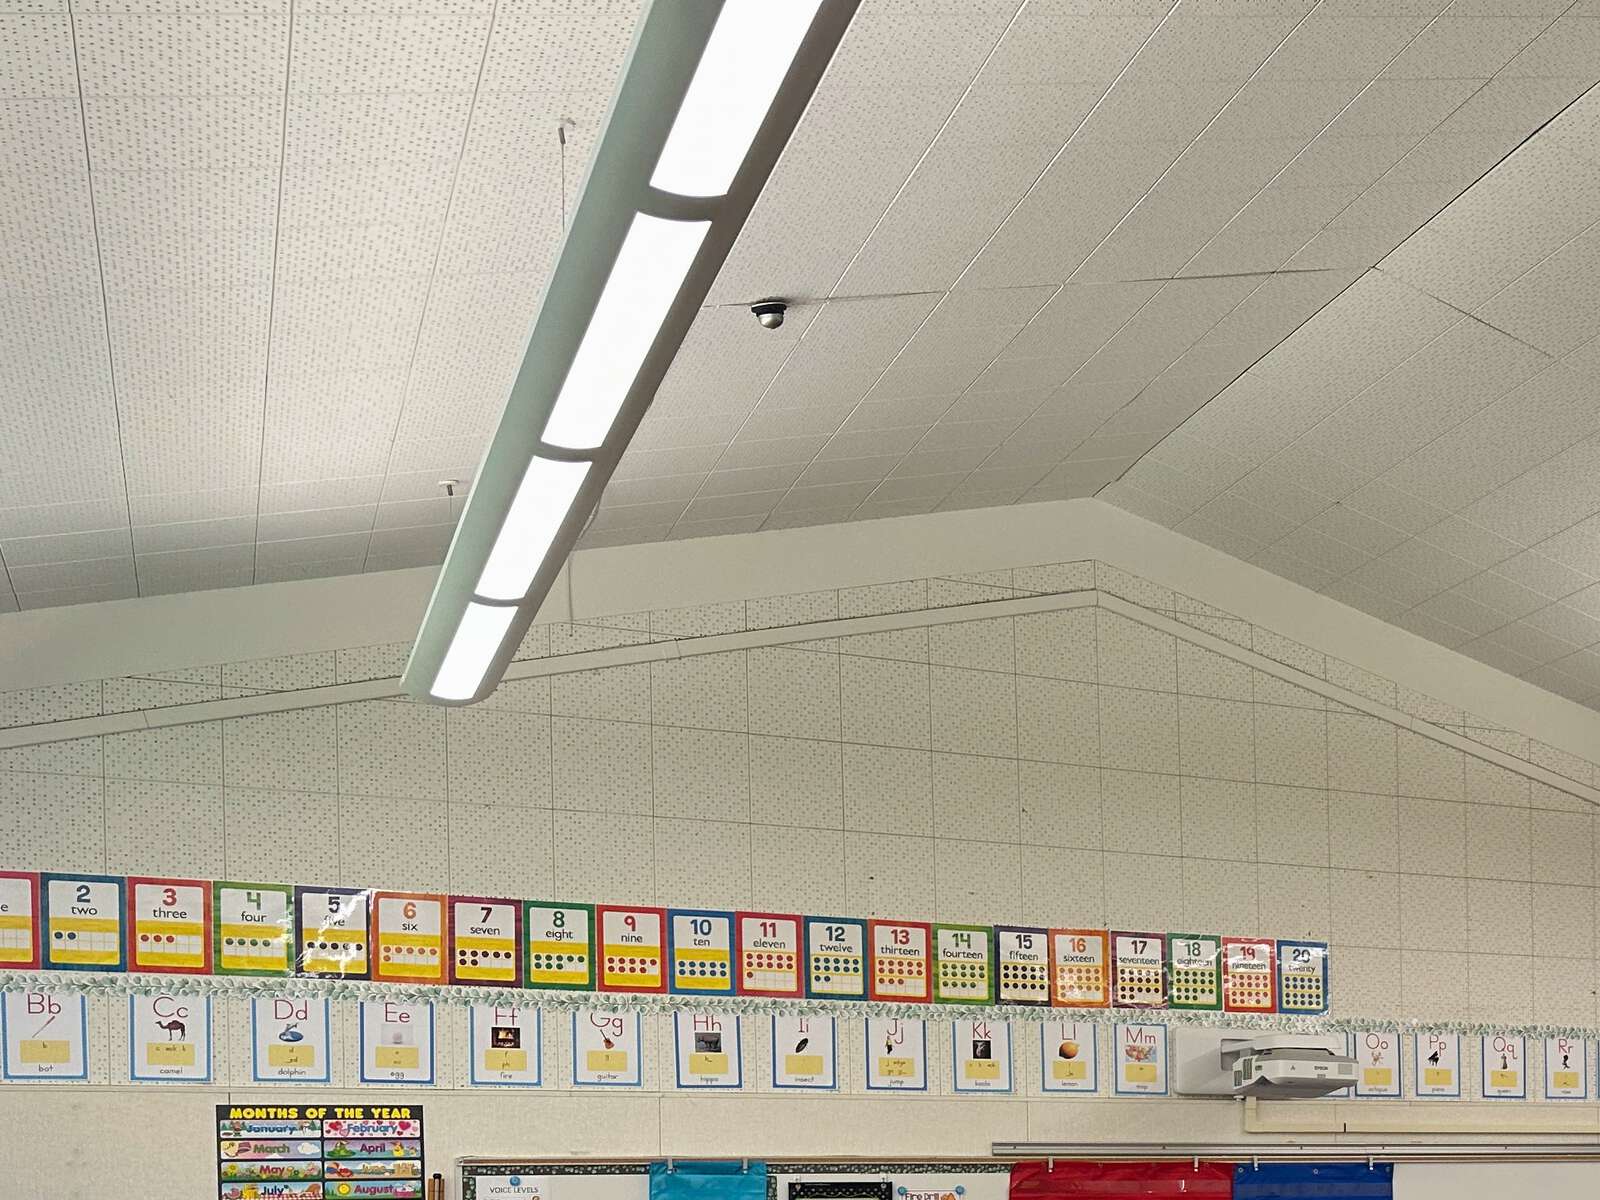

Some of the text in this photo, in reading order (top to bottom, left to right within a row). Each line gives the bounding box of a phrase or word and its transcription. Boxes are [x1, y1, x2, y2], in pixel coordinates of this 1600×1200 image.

[75, 885, 91, 902] 2
[162, 888, 177, 905] 3
[246, 892, 262, 909] 4
[71, 906, 97, 916] two
[328, 896, 340, 913] 5
[403, 902, 417, 919] 6
[152, 908, 187, 919] three
[241, 911, 267, 923] four
[480, 907, 492, 923] 7
[553, 911, 565, 928] 8
[401, 922, 418, 931] six
[470, 926, 500, 935] seven
[624, 916, 636, 931] 9
[690, 919, 712, 936] 10
[760, 922, 777, 938] 11
[545, 929, 574, 941] eight
[620, 934, 643, 943] nine
[825, 926, 846, 942] 12
[891, 929, 910, 944] 13
[952, 933, 970, 949] 14
[1015, 934, 1033, 949] 15
[693, 938, 710, 947] ten
[753, 939, 786, 950] eleven
[820, 943, 853, 953] twelve
[1068, 938, 1086, 953] 16
[1131, 940, 1148, 954] 17
[1185, 942, 1201, 957] 18
[880, 946, 920, 957] thirteen
[942, 949, 983, 960] fourteen
[1009, 950, 1039, 961] fifteen
[1063, 953, 1095, 963] sixteen
[1240, 946, 1256, 960] 19
[1292, 949, 1311, 963] 20
[1119, 956, 1160, 966] seventeen
[27, 994, 62, 1015] Bb
[152, 997, 189, 1018] Cc
[274, 1000, 308, 1021] Dd
[384, 1004, 411, 1023] Ee
[590, 1012, 624, 1037] Gg
[693, 1014, 722, 1032] Hh
[972, 1022, 991, 1039] Kk
[1061, 1023, 1076, 1040] Ll
[1126, 1027, 1156, 1044] Mm
[1365, 1033, 1388, 1050] Oo
[1429, 1035, 1447, 1057] Pp
[1493, 1036, 1518, 1060] Qq
[1558, 1039, 1574, 1054] Rr
[278, 1068, 307, 1077] dolphin
[229, 1108, 411, 1119] MONTHS OF THE YEAR
[245, 1124, 297, 1135] January
[346, 1123, 398, 1135] February
[252, 1143, 291, 1154] March
[360, 1143, 386, 1155] April
[259, 1165, 285, 1176] May
[261, 1185, 285, 1198] July
[354, 1184, 393, 1196] August
[905, 1192, 923, 1200] Fire
